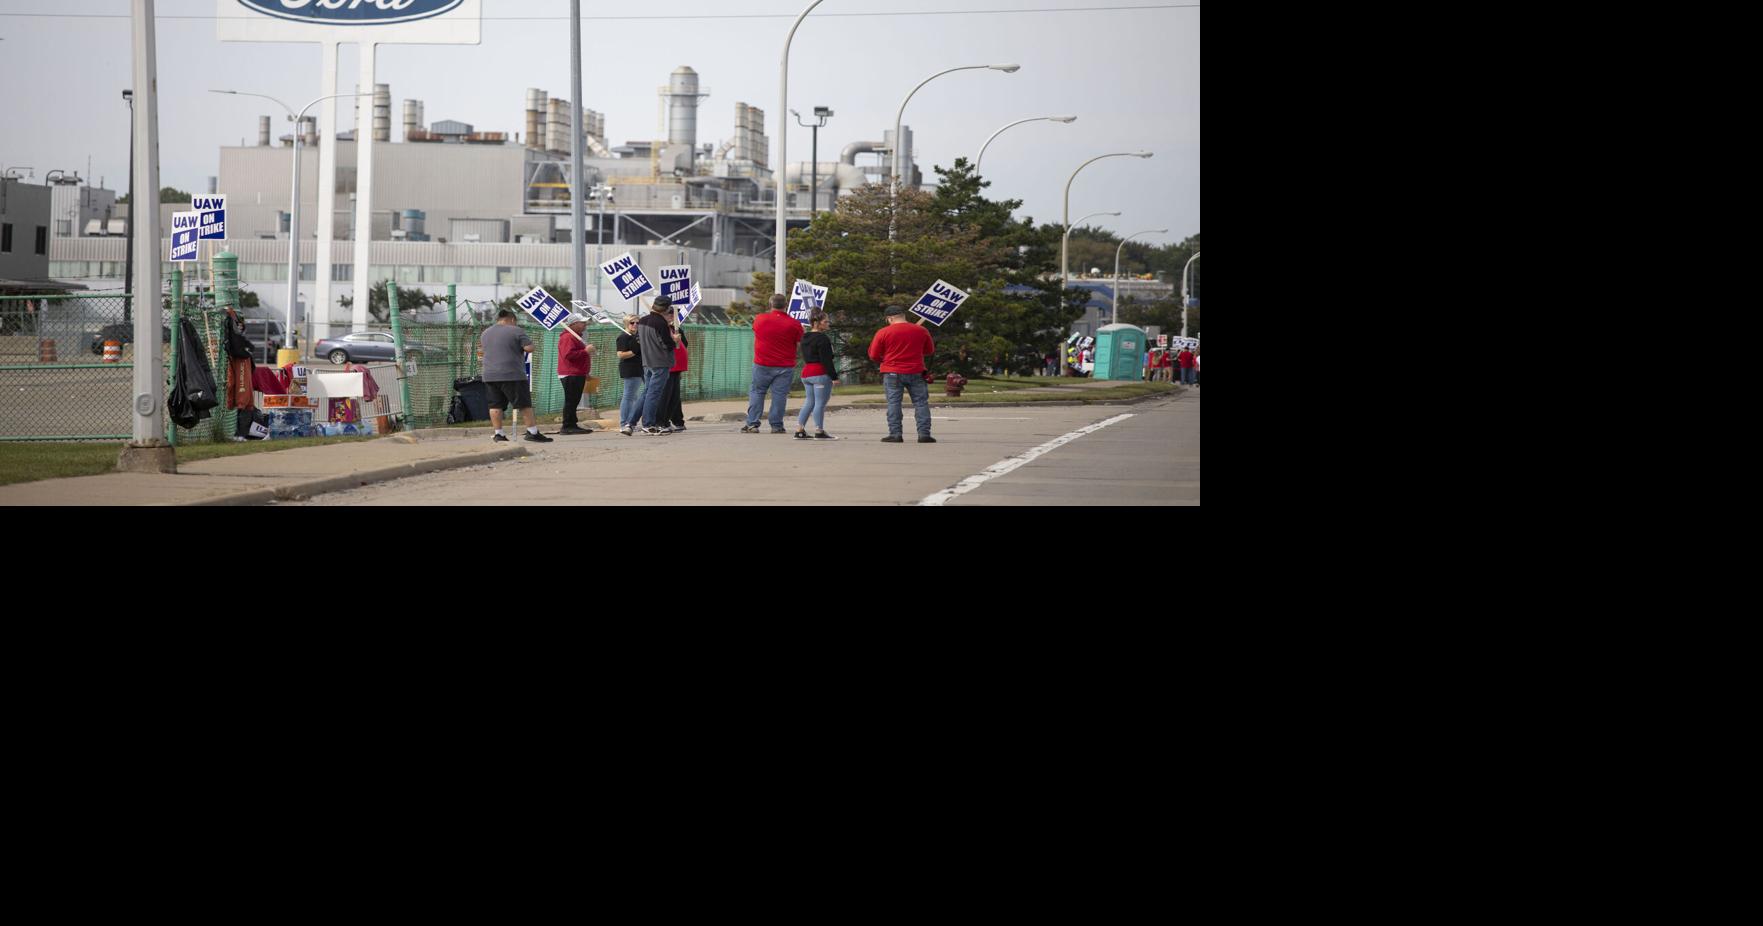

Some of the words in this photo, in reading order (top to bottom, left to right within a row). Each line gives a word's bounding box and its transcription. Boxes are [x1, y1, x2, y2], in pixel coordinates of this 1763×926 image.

[194, 198, 224, 210] UAW
[173, 216, 198, 229] UAW
[203, 213, 215, 225] ON
[200, 222, 224, 237] TRIKE
[179, 232, 190, 245] ON
[172, 241, 197, 259] STRIKE
[604, 256, 633, 275] UAW
[621, 271, 635, 285] ON
[660, 268, 689, 280] UAW
[621, 274, 647, 299] STRIKE
[670, 281, 681, 293] ON
[794, 285, 825, 300] UW
[933, 283, 964, 302] UAW
[520, 289, 547, 310] UAW
[930, 299, 947, 309] ON
[539, 302, 552, 316] ON
[542, 304, 564, 328] STRIKE
[914, 303, 949, 319] STRIKE
[296, 367, 307, 377] UA
